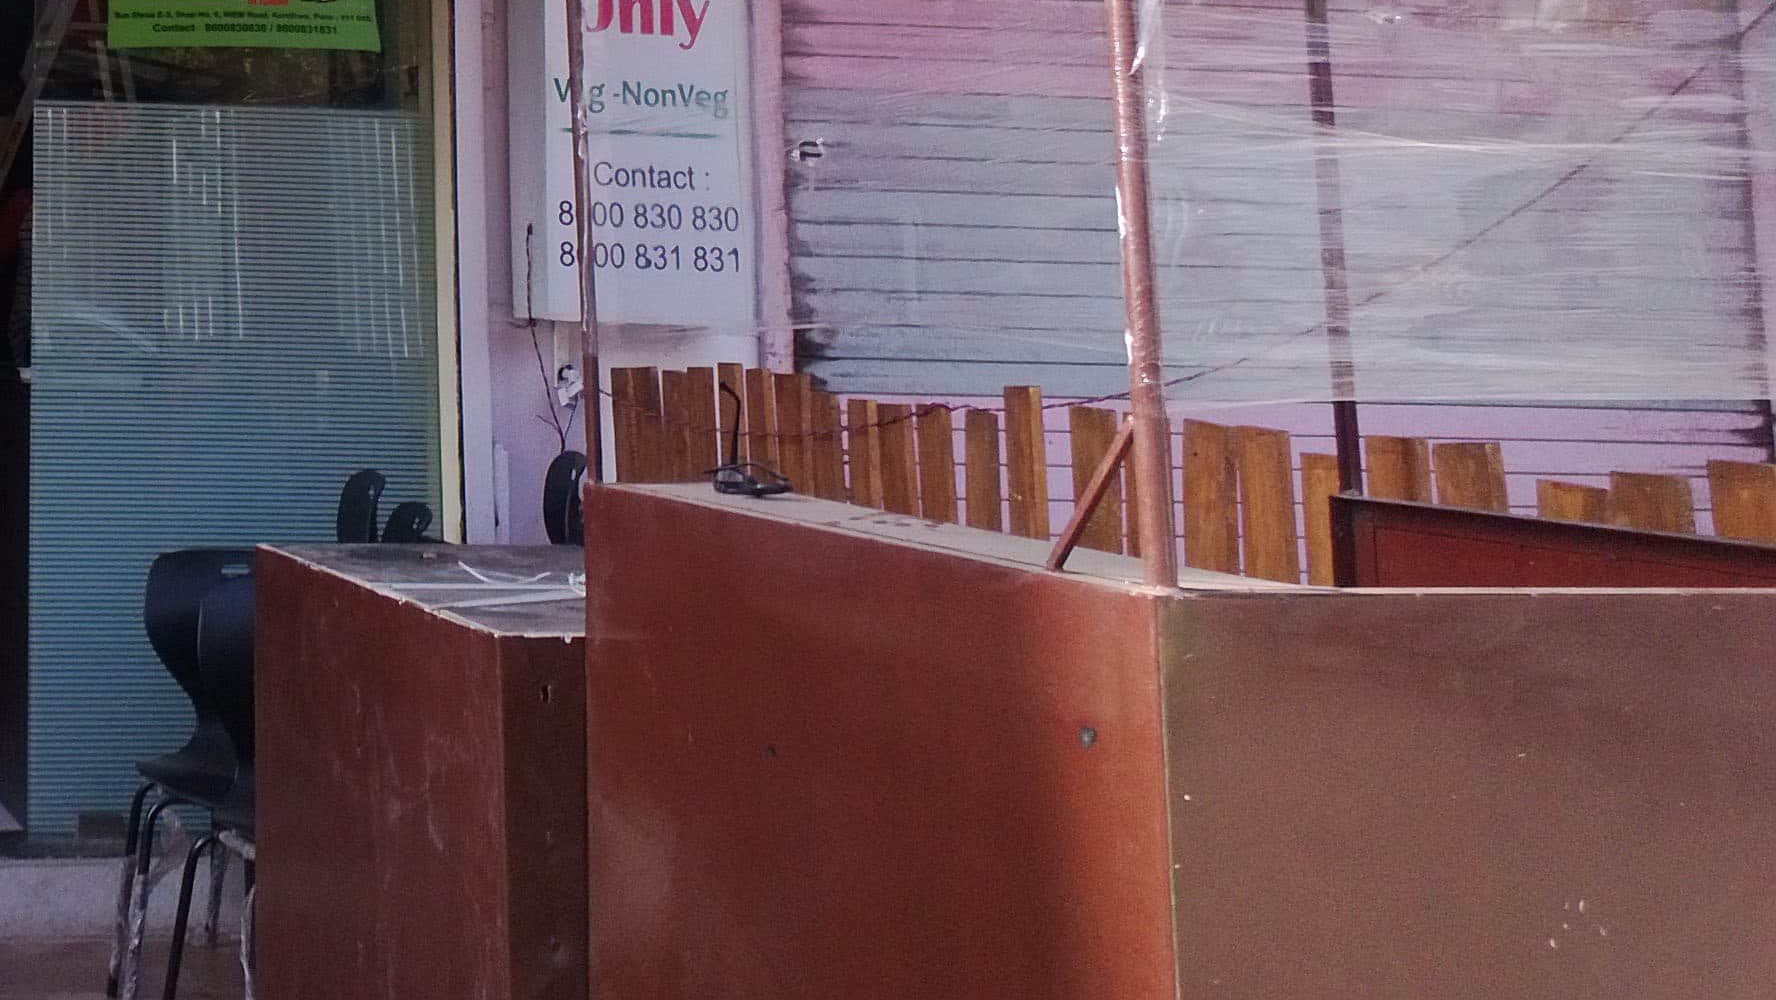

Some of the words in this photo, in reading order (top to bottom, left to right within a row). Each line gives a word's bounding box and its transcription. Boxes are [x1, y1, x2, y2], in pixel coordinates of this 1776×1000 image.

[553, 77, 605, 113] Vg
[593, 161, 695, 190] Contact
[559, 200, 624, 228] 800
[633, 203, 682, 230] 830
[692, 205, 739, 232] 830
[560, 241, 625, 269] 800
[635, 243, 681, 271] 831
[693, 246, 740, 273] 831
